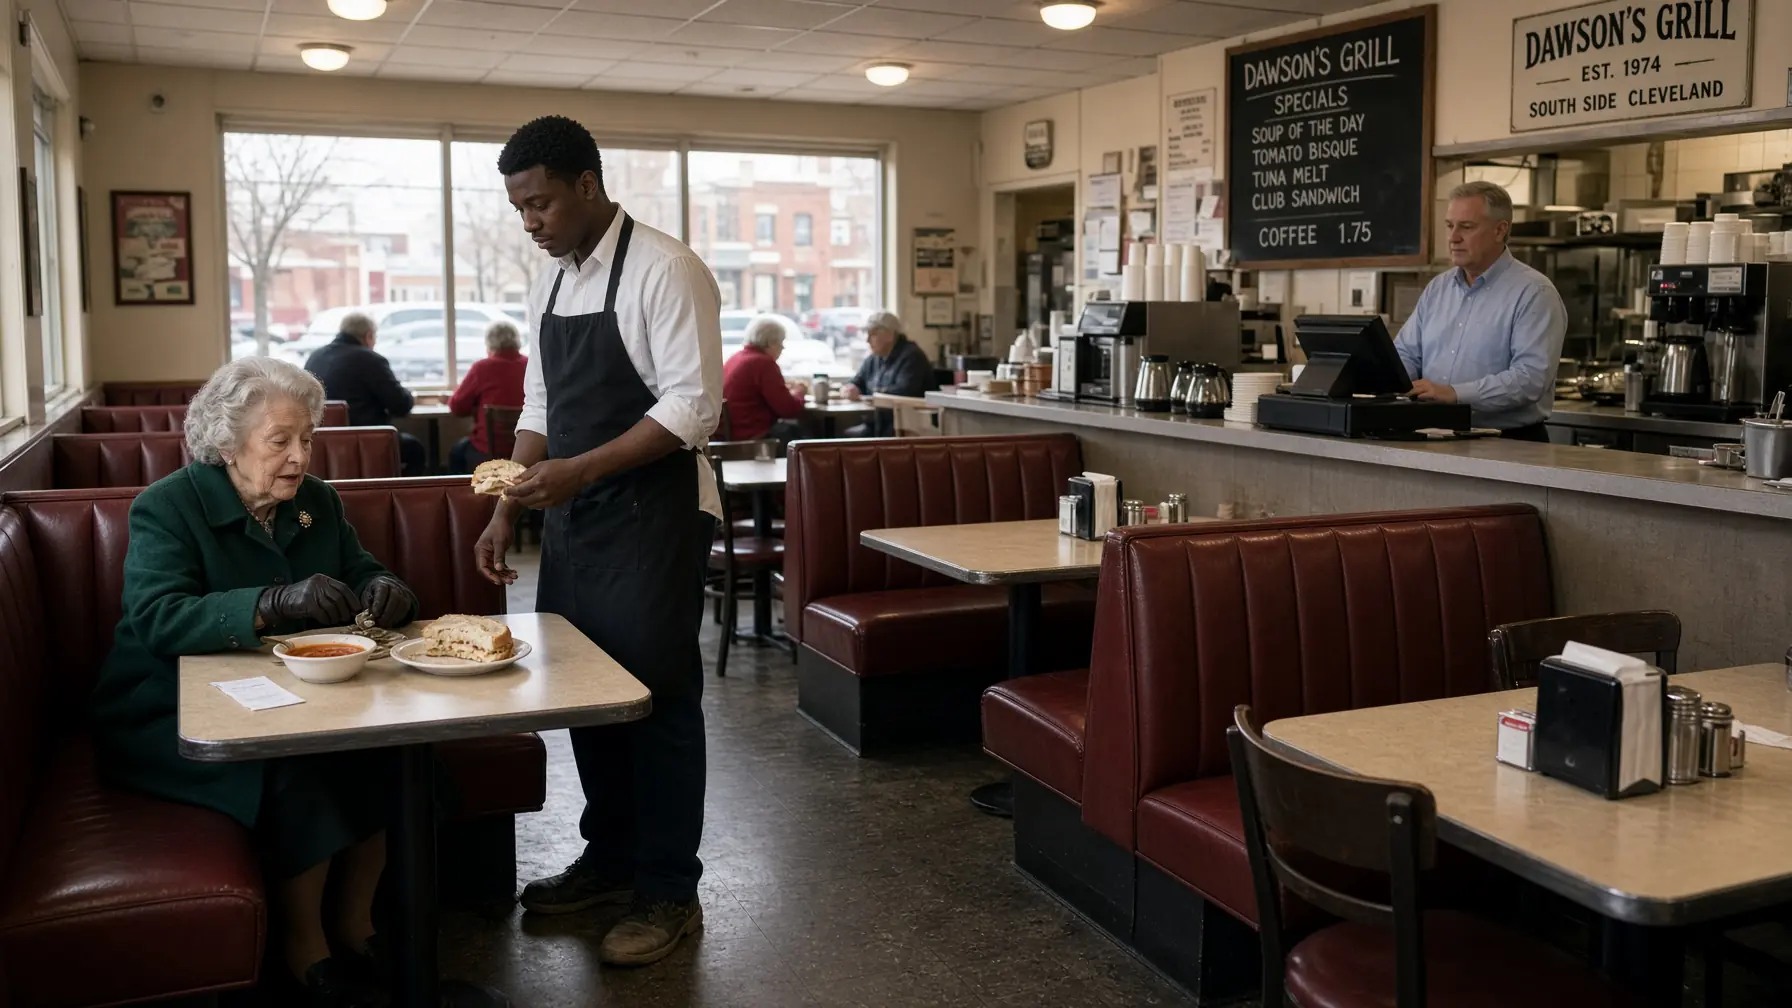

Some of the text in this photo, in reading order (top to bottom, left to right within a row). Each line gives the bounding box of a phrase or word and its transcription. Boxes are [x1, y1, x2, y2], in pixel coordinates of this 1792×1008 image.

[1525, 0, 1736, 70] DAWSON'S GRILL
[1244, 35, 1400, 90] DAWSON'S GRILL
[1581, 55, 1661, 82] EST. 1974
[1274, 86, 1348, 115] SPECIALS
[1529, 80, 1724, 118] SOUTH SIDE CLEVELAND
[1252, 113, 1365, 144] SOUP OF THE DAY
[1252, 138, 1358, 166] TOMATO BISQUE
[1252, 164, 1329, 188] TUNA MELT
[1252, 185, 1360, 211] CLUB SANDWICH
[1259, 221, 1372, 247] COFFEE 1.75
